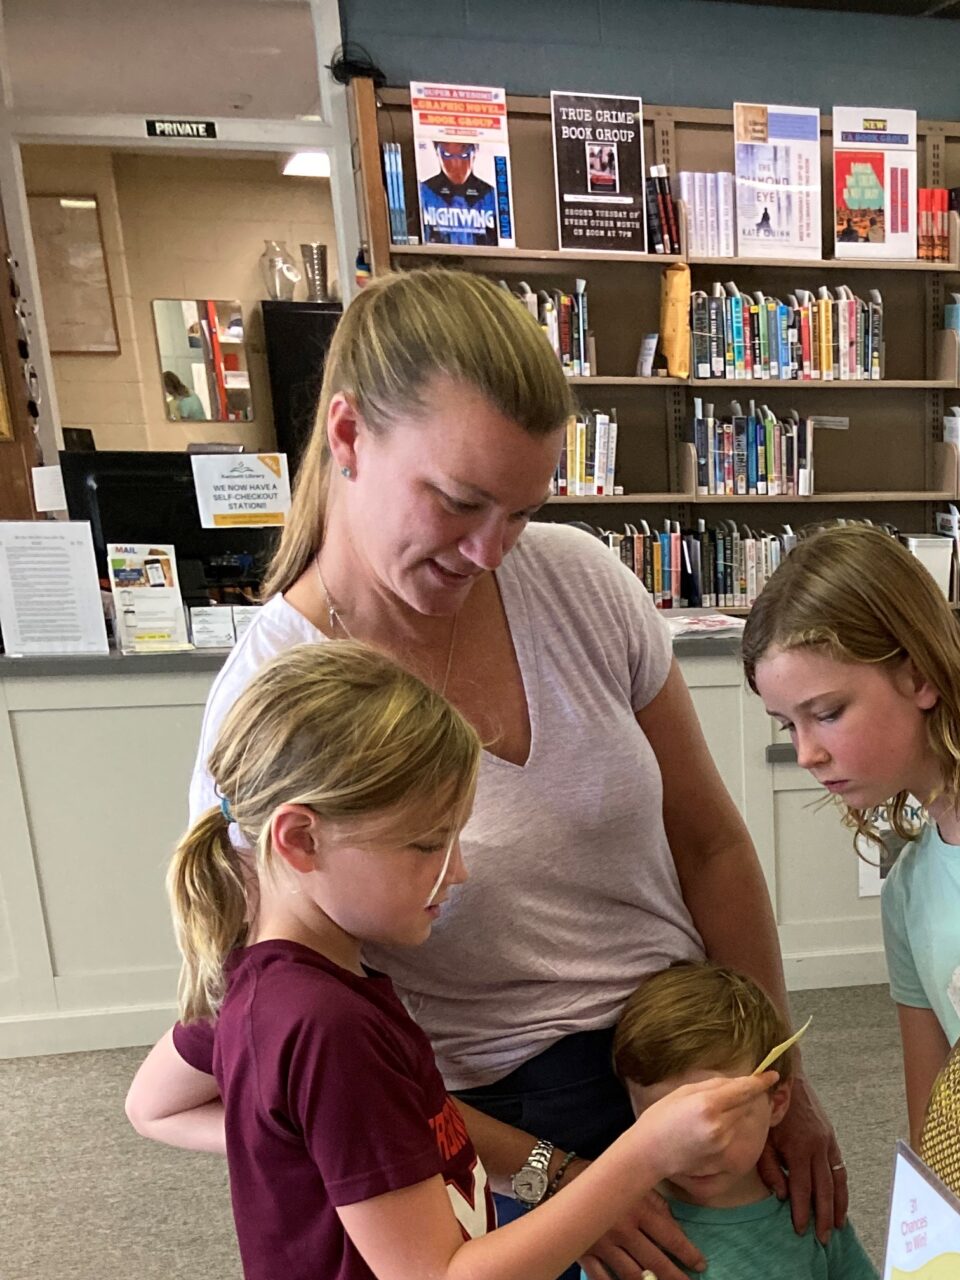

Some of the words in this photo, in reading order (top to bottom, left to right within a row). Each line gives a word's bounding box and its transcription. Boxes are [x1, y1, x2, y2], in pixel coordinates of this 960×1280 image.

[560, 108, 593, 122] TRUE
[595, 111, 634, 124] CRIME
[155, 122, 207, 136] PRIVATE
[561, 126, 593, 140] BOOK
[596, 129, 635, 142] GROUP
[756, 191, 775, 203] EYE
[424, 207, 494, 229] NIGHTWING
[213, 484, 226, 492] WE
[249, 483, 271, 491] HAVE
[901, 1215, 929, 1237] Chances
